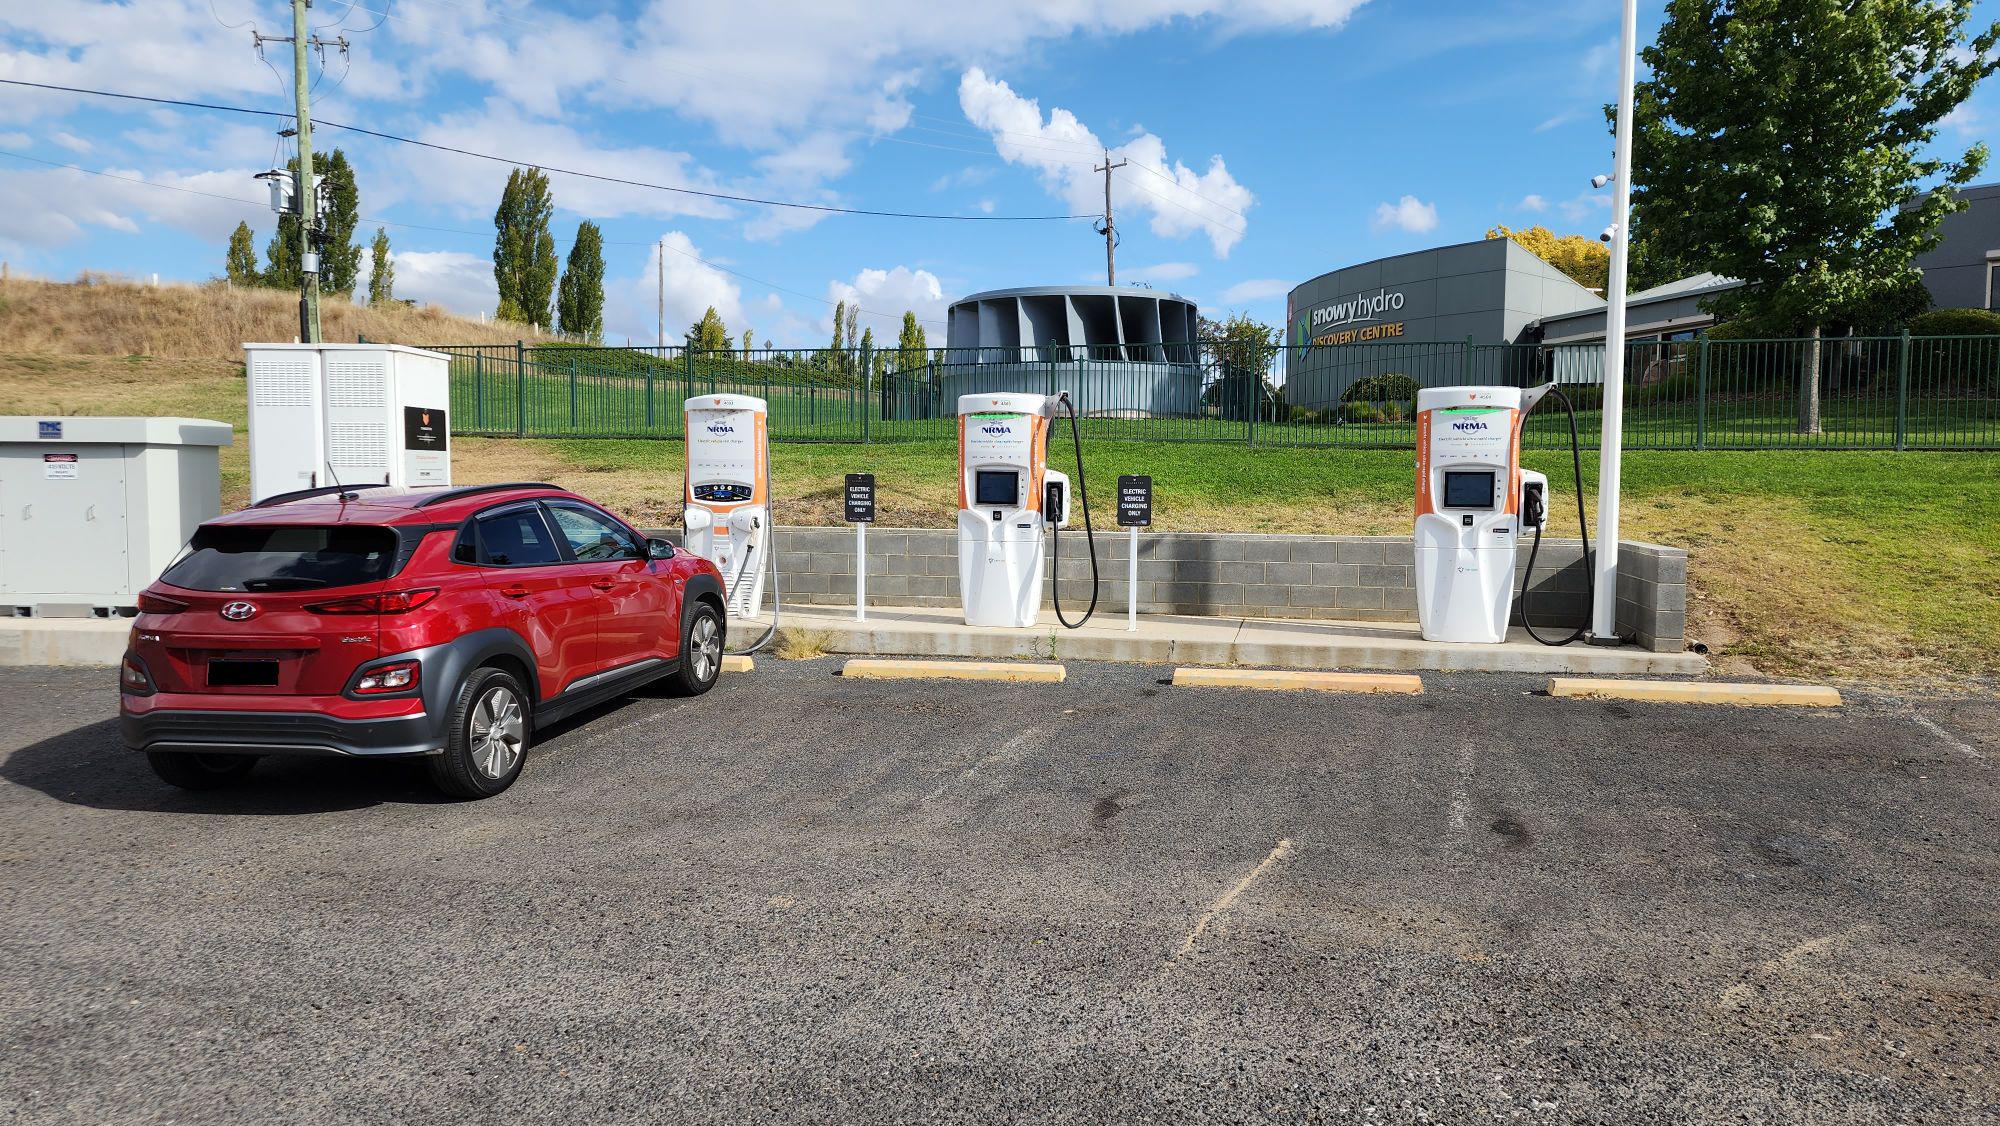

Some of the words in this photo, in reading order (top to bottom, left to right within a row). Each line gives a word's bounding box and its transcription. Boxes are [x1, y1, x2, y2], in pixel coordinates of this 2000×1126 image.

[1312, 330, 1358, 346] DISCOVERY
[1360, 322, 1404, 341] CENTRE
[1452, 422, 1488, 430] NRMA
